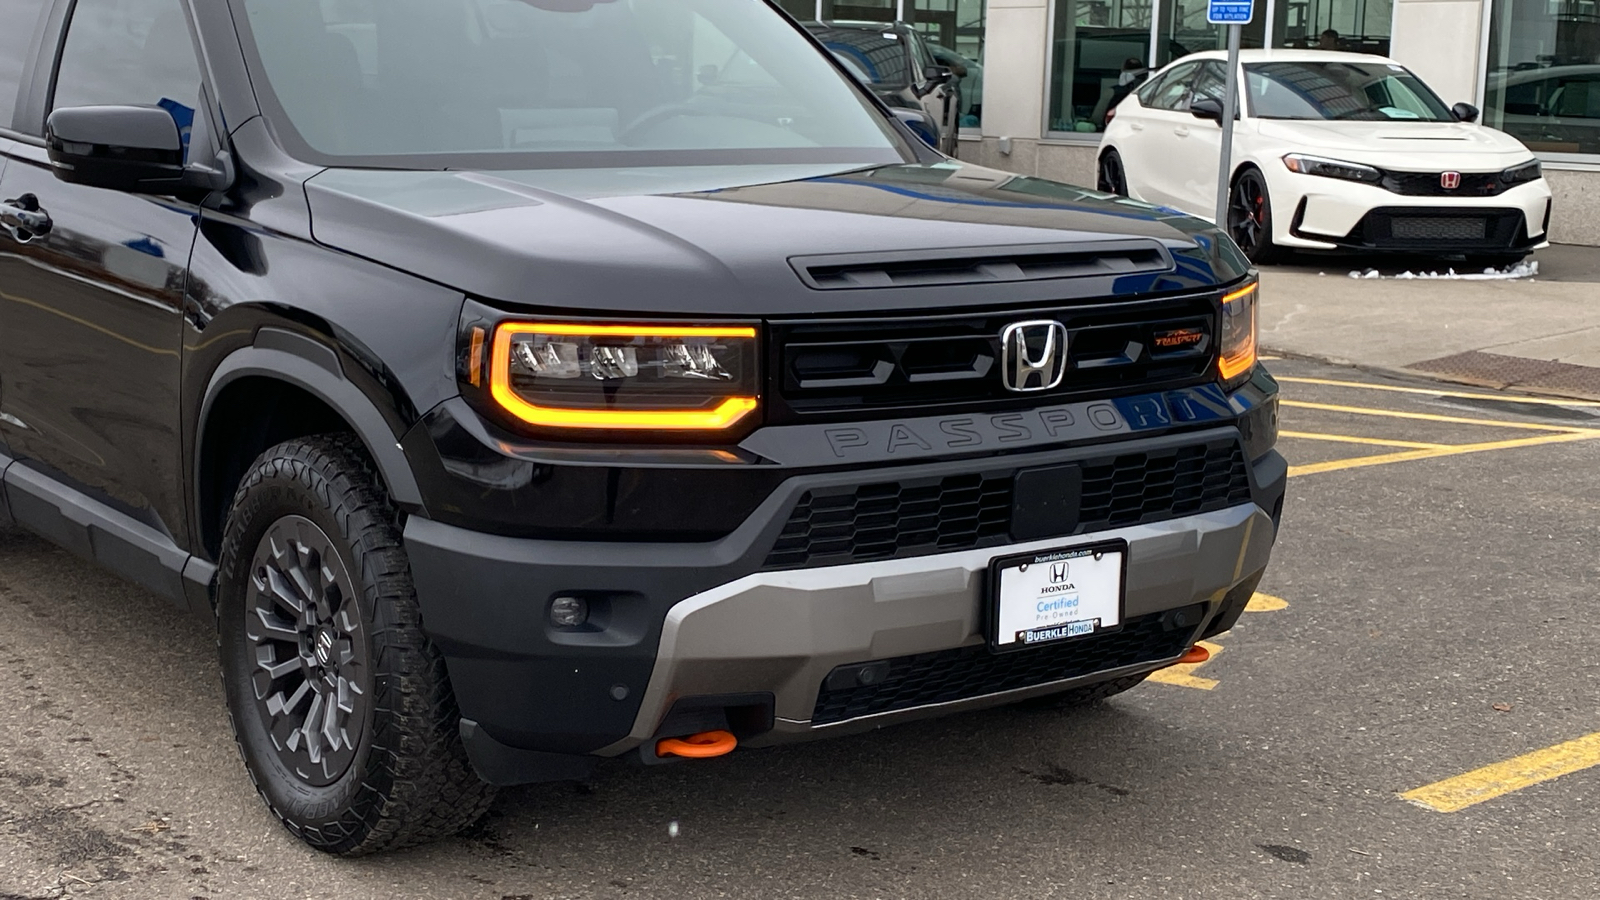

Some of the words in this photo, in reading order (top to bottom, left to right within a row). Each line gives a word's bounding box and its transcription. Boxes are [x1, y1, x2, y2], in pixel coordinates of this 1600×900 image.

[823, 396, 1197, 458] PASSPORT
[1034, 549, 1092, 563] buerklehonda.com
[1040, 583, 1076, 594] HONDA
[1036, 595, 1079, 613] Certified
[1026, 627, 1068, 643] BUERKLE
[1068, 623, 1093, 636] HONDA
